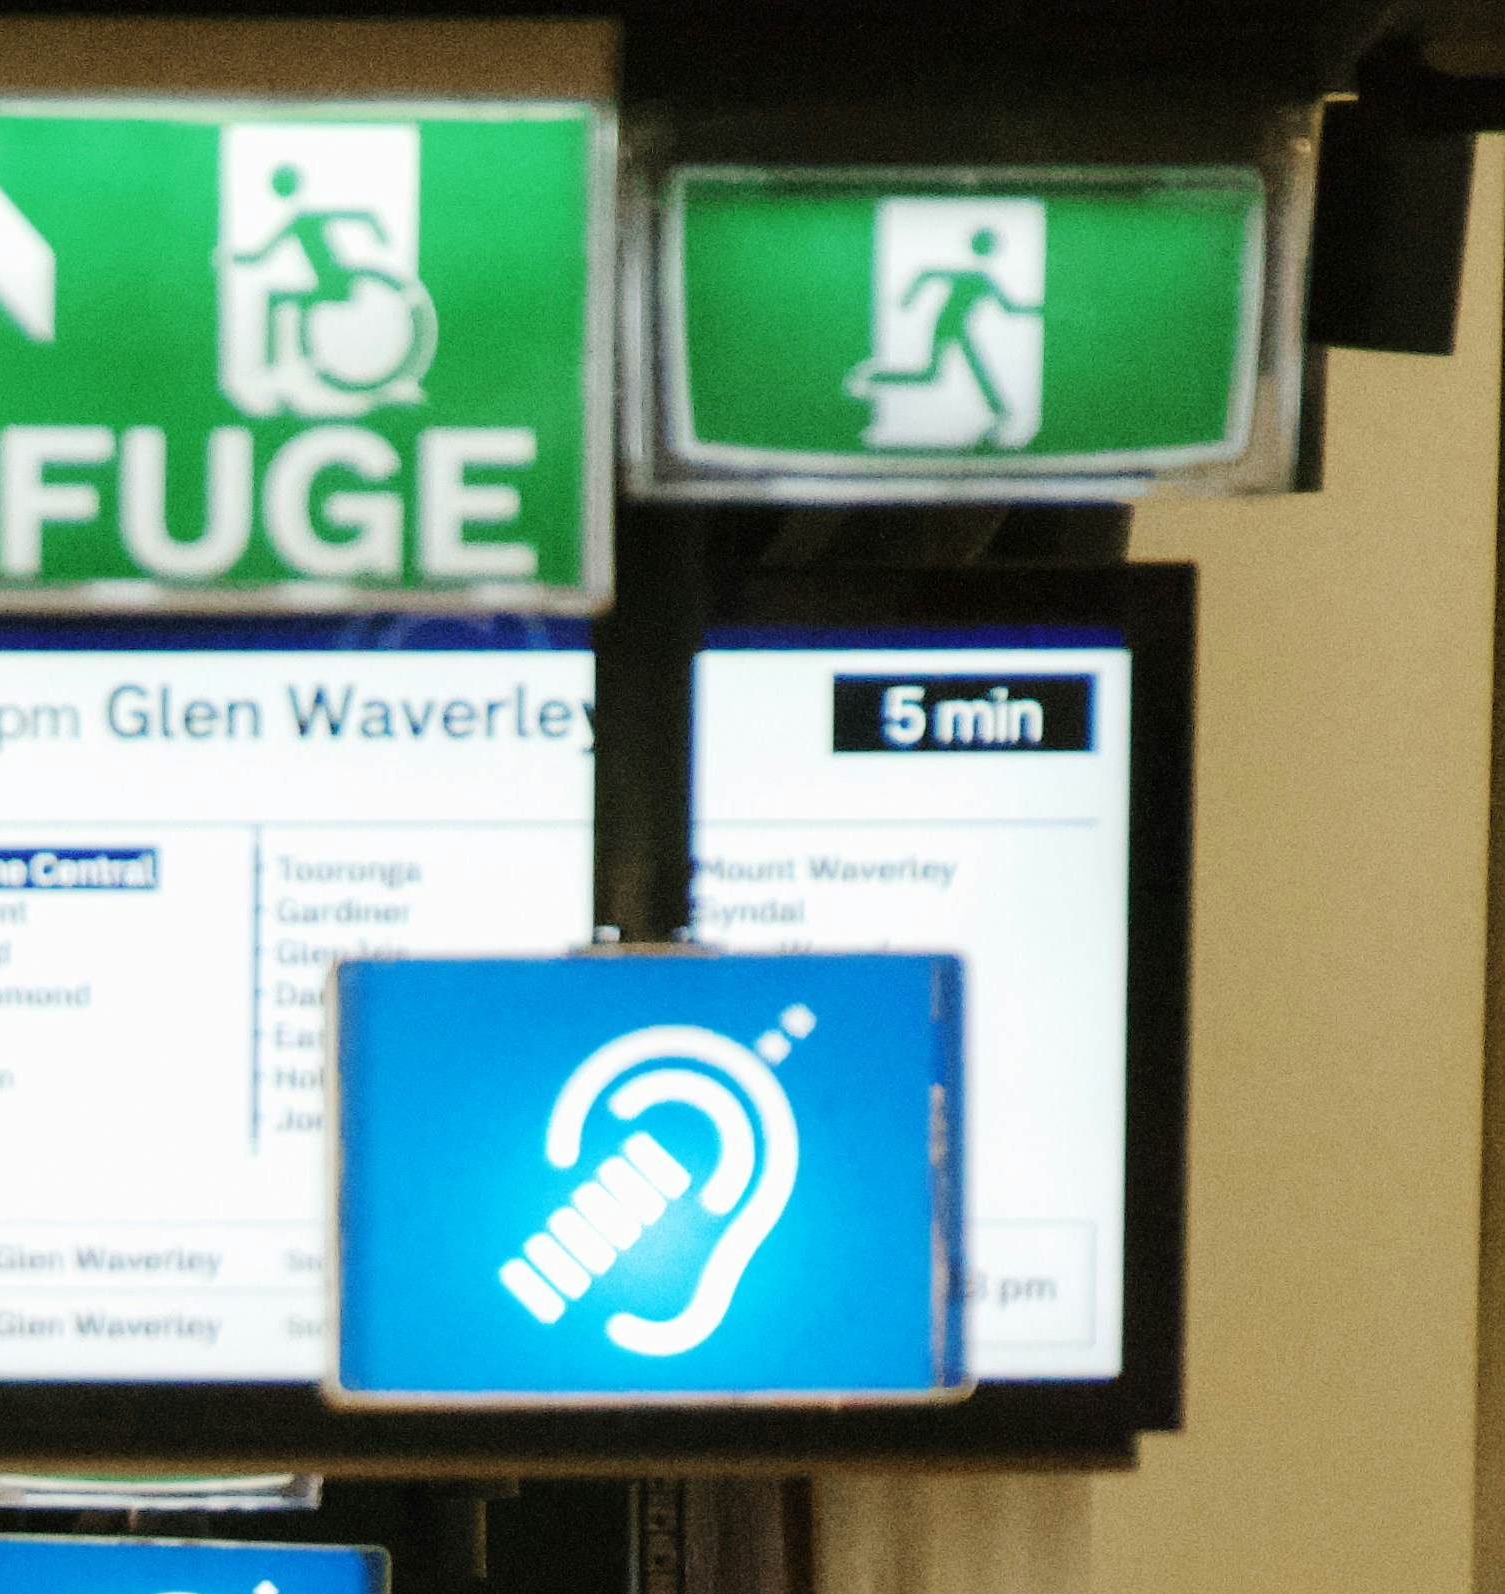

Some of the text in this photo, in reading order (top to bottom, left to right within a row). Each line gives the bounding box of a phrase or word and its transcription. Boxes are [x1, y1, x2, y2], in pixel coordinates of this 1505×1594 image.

[106, 684, 263, 741] Glen
[881, 685, 1044, 746] 5 min
[29, 853, 156, 887] Central
[277, 855, 421, 889] Tooronga
[808, 855, 958, 891] Waverley
[276, 897, 410, 925] Gardiner
[75, 1242, 223, 1283] Waverley
[75, 1309, 223, 1347] Waverley
